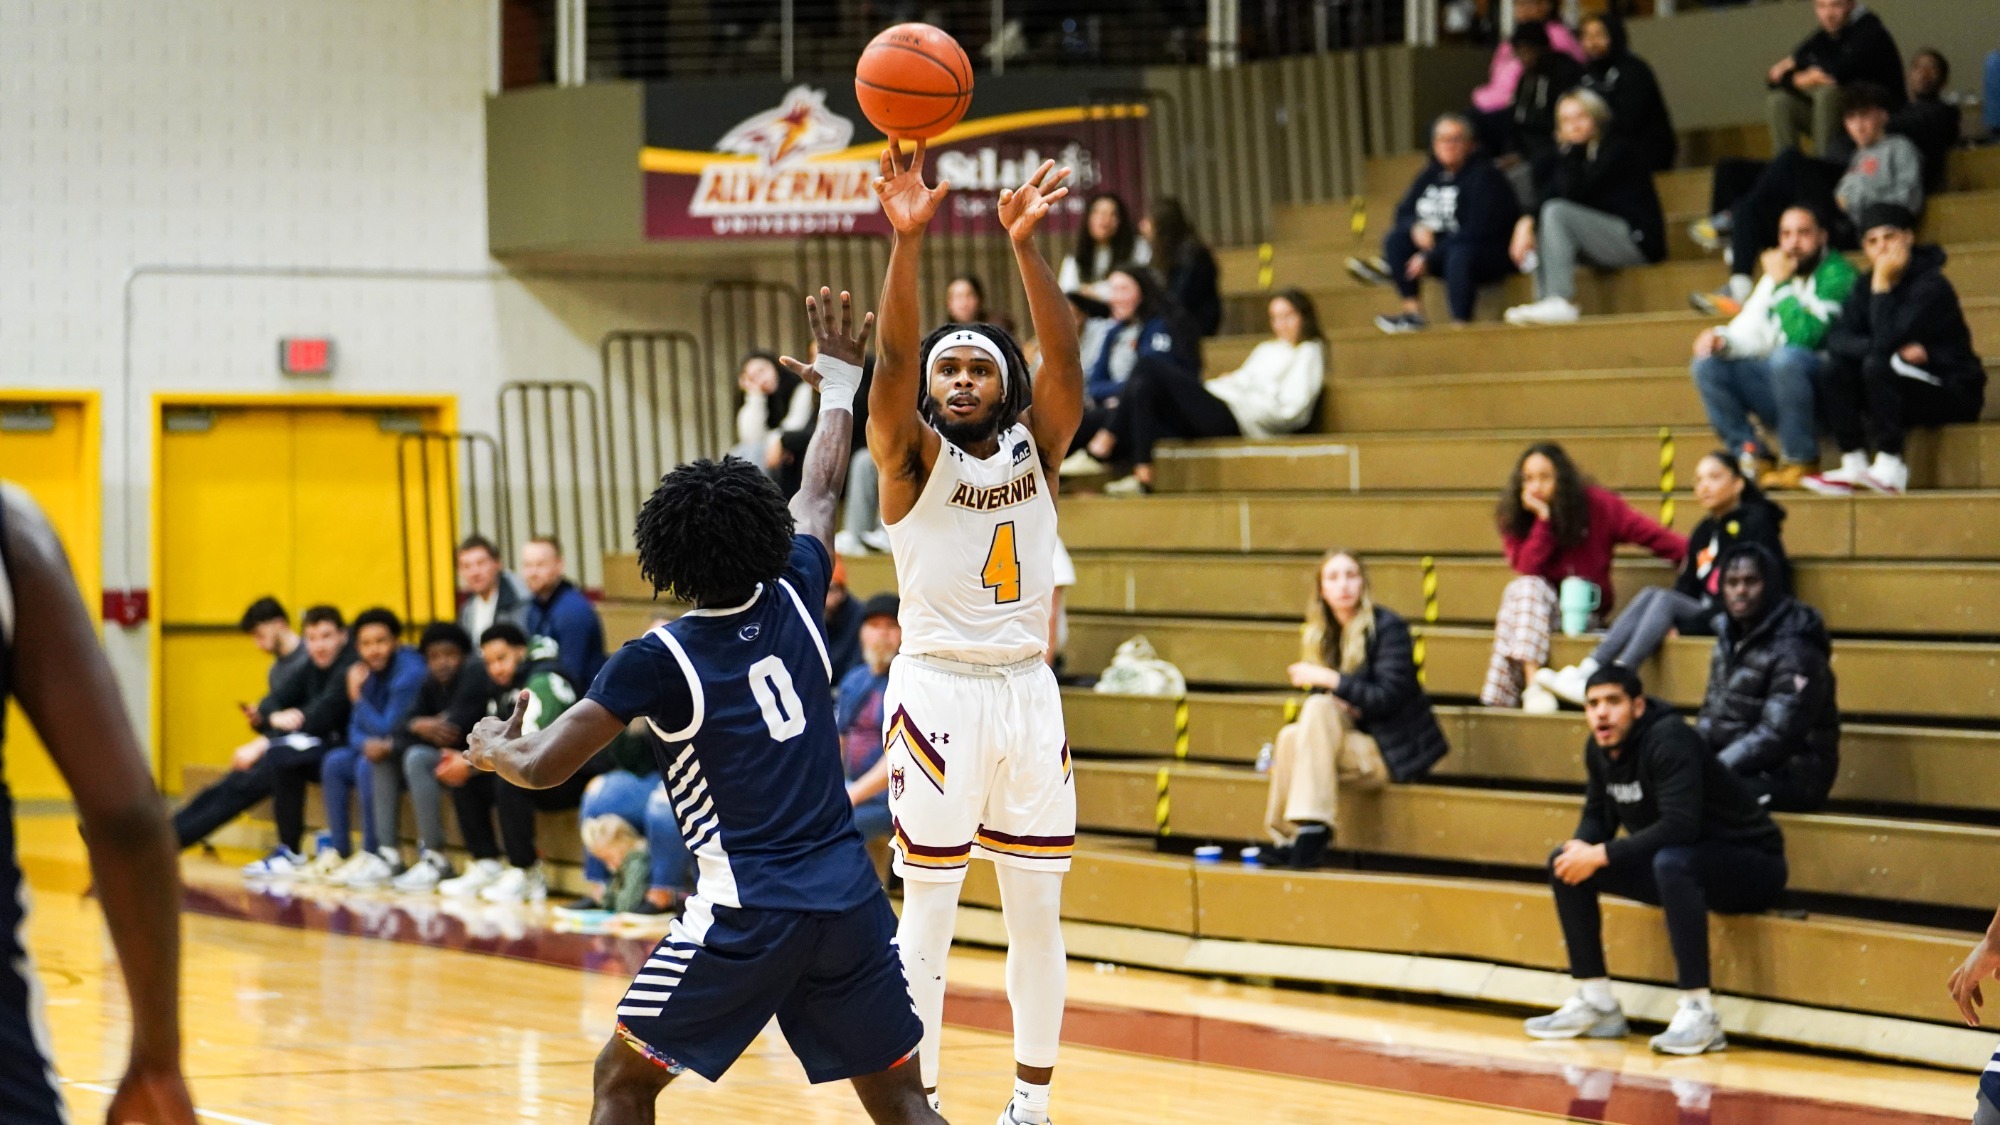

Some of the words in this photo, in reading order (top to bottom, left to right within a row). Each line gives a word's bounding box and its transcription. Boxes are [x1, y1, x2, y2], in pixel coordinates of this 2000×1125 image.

[705, 171, 868, 203] ALVERNIA
[712, 213, 857, 235] UNIVERSITY
[1013, 446, 1031, 465] MAC
[951, 471, 1038, 511] ALVERNIA
[981, 520, 1021, 605] 4
[748, 654, 807, 743] 0
